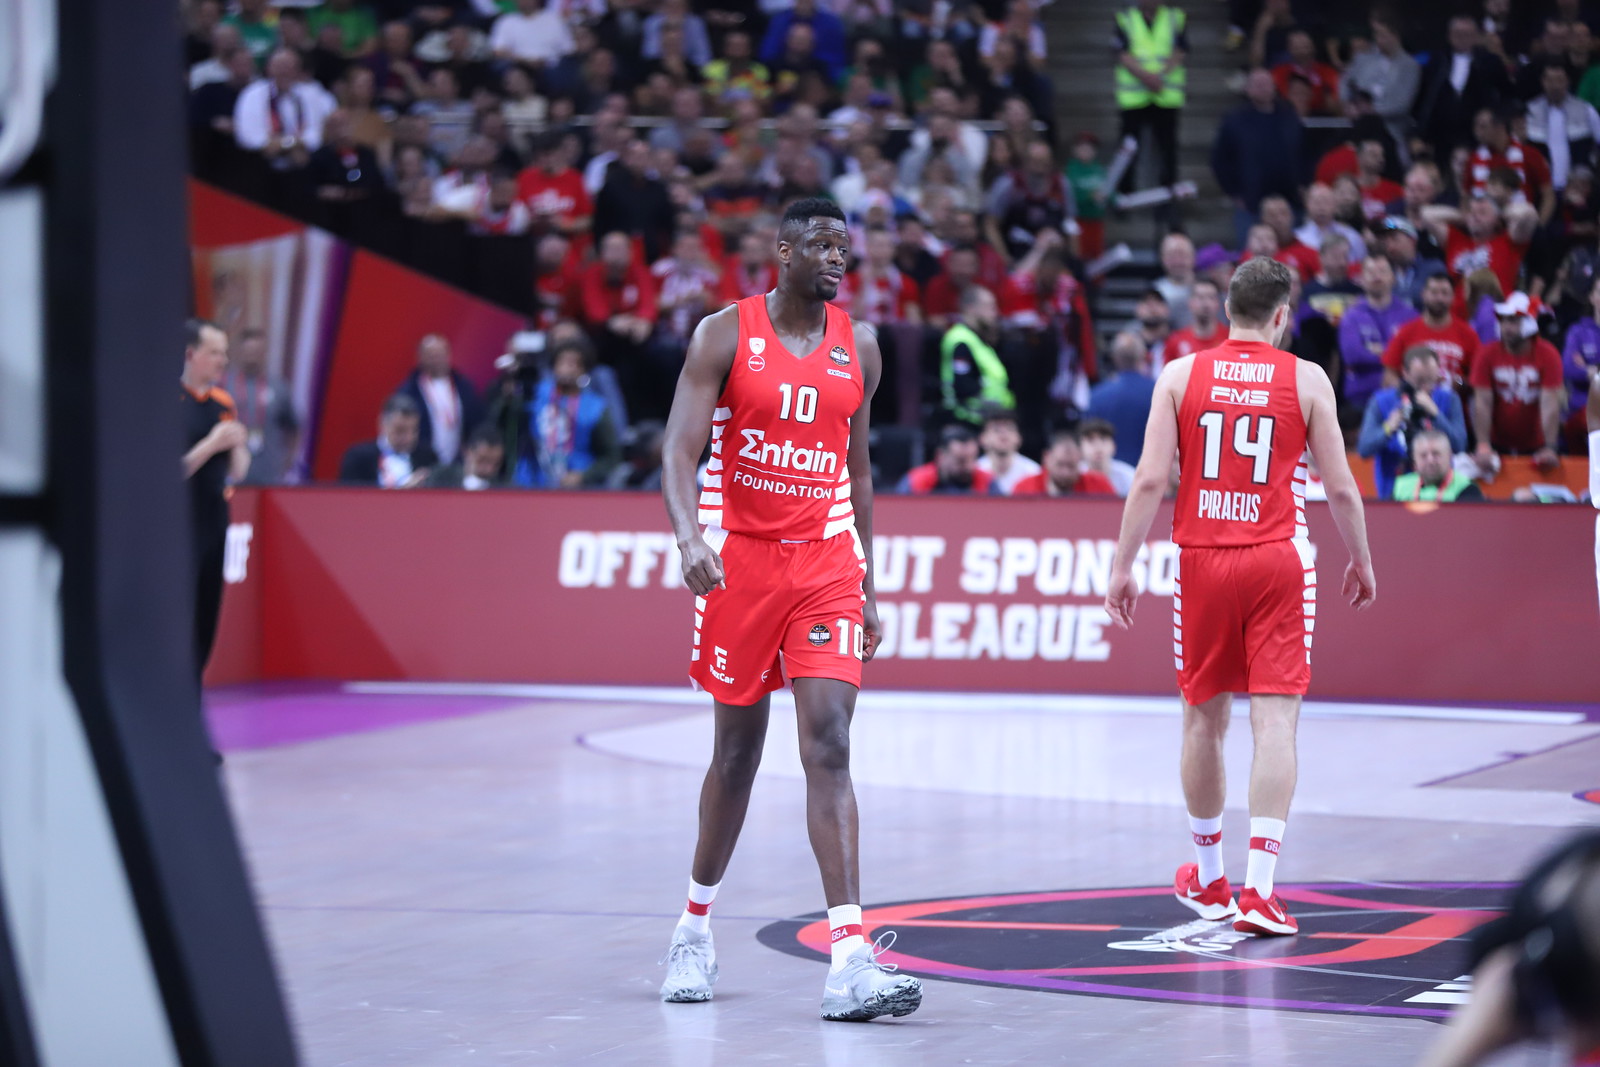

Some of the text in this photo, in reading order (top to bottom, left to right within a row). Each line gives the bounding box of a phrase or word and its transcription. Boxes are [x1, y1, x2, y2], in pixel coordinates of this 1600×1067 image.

[1213, 360, 1275, 383] VEZENKOV
[779, 383, 819, 424] 10
[1211, 386, 1270, 405] FMS
[1198, 411, 1275, 485] 14
[733, 471, 833, 499] FOUNDATION
[1198, 490, 1261, 523] PIRAEUS
[558, 530, 690, 589] OFFI
[872, 535, 946, 593] UT
[836, 618, 863, 661] 10
[874, 602, 1111, 661] OLEAGUE
[831, 927, 849, 941] GSA
